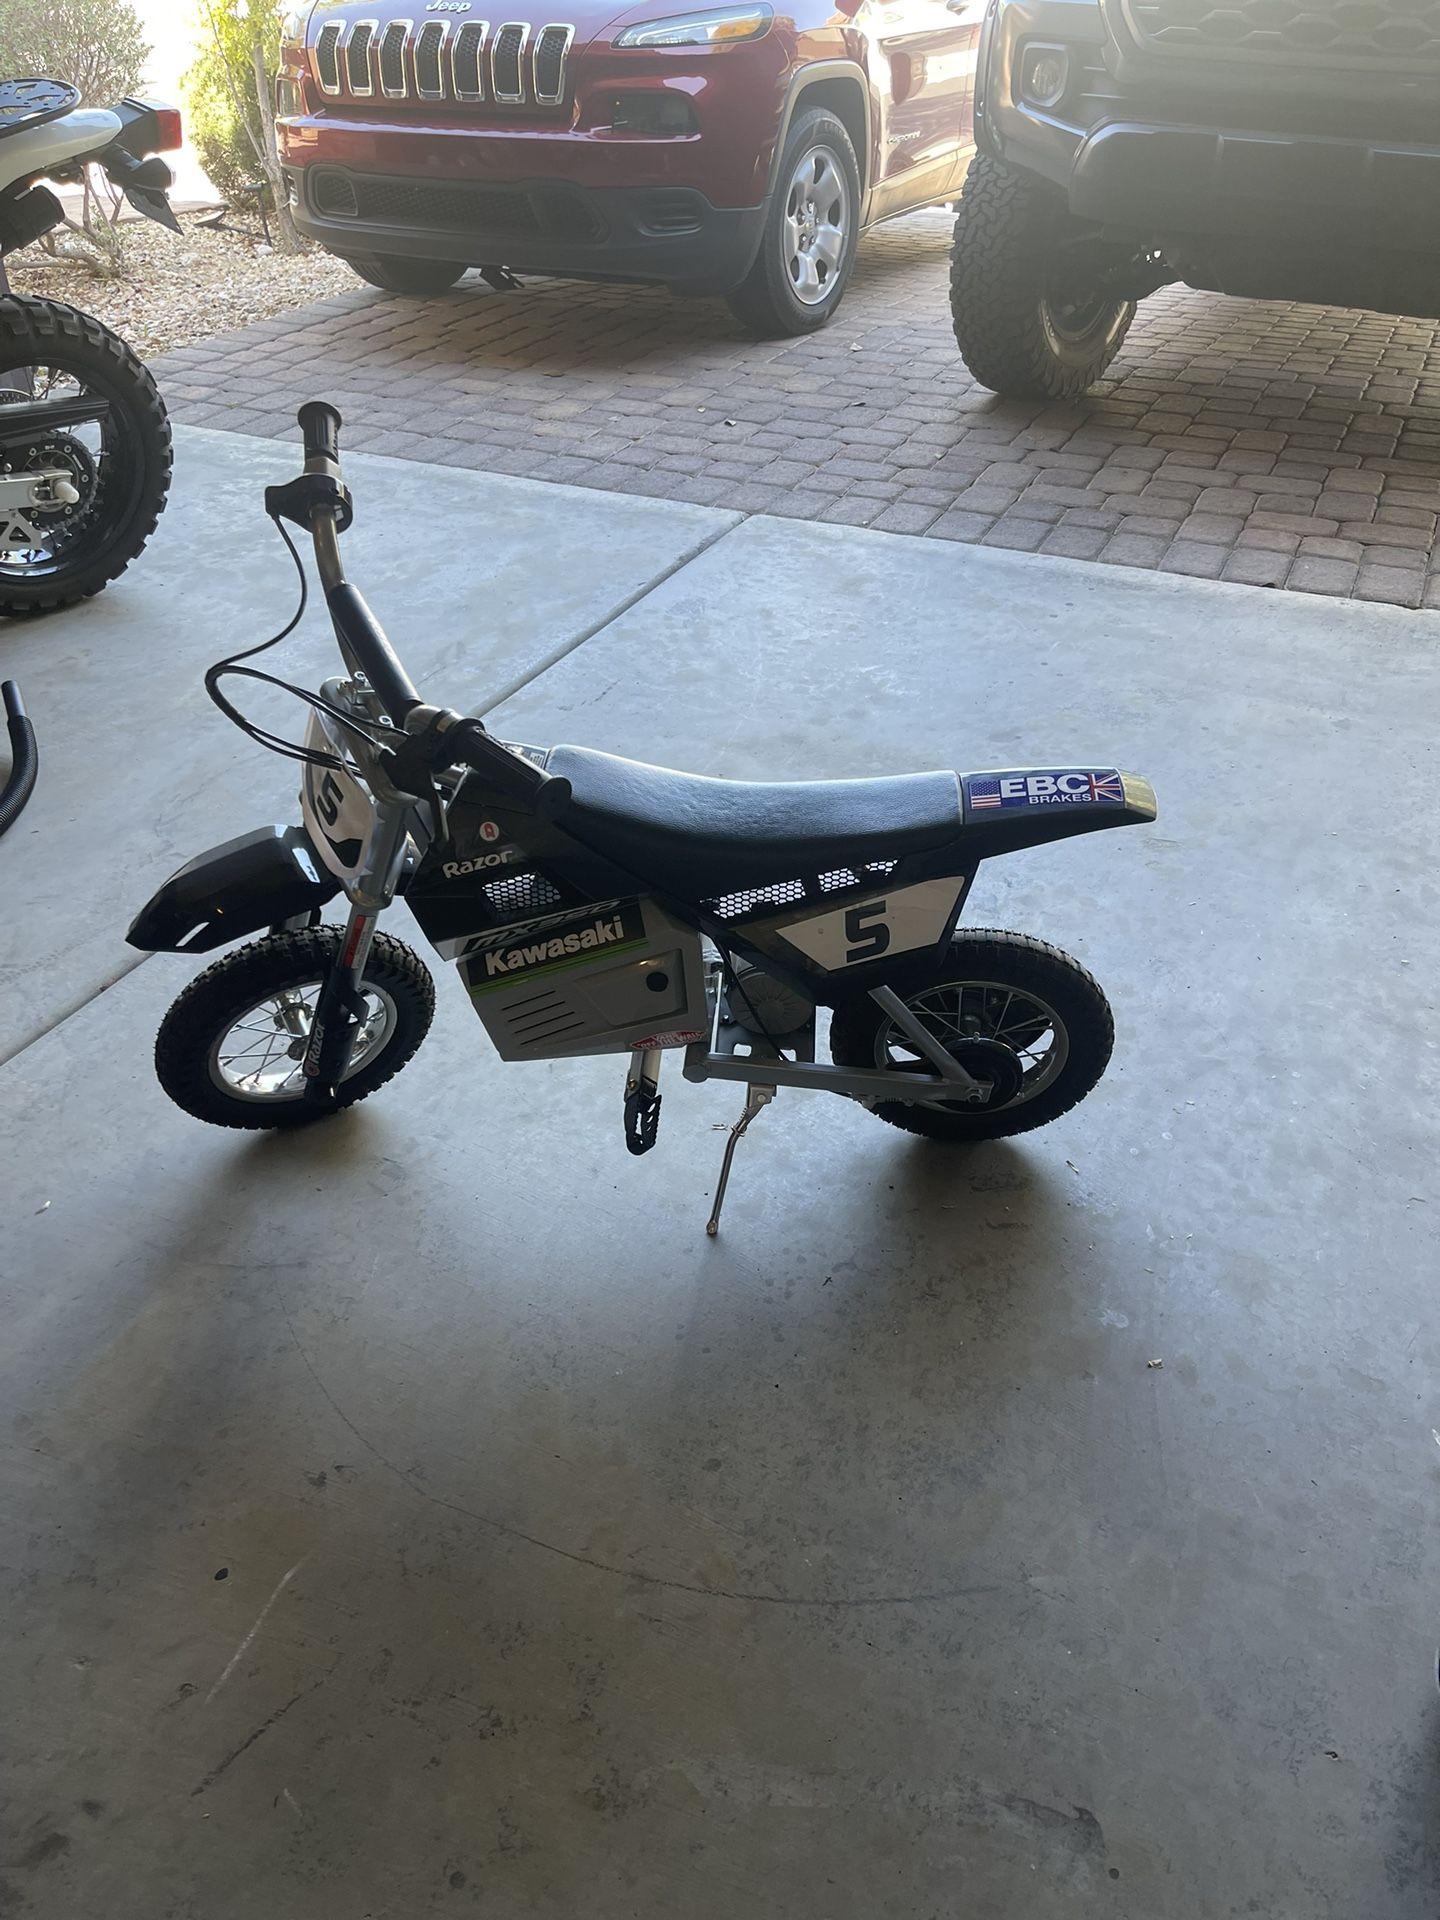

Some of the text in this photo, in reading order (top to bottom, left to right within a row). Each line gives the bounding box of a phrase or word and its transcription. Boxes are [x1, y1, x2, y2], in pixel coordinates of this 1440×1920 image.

[426, 0, 472, 14] Jeep
[1000, 773, 1090, 798] EBC
[1029, 793, 1092, 805] BRAKES
[442, 850, 512, 879] Razor
[485, 915, 625, 976] Kawasaki
[845, 900, 890, 963] 5
[307, 1022, 326, 1064] Razor
